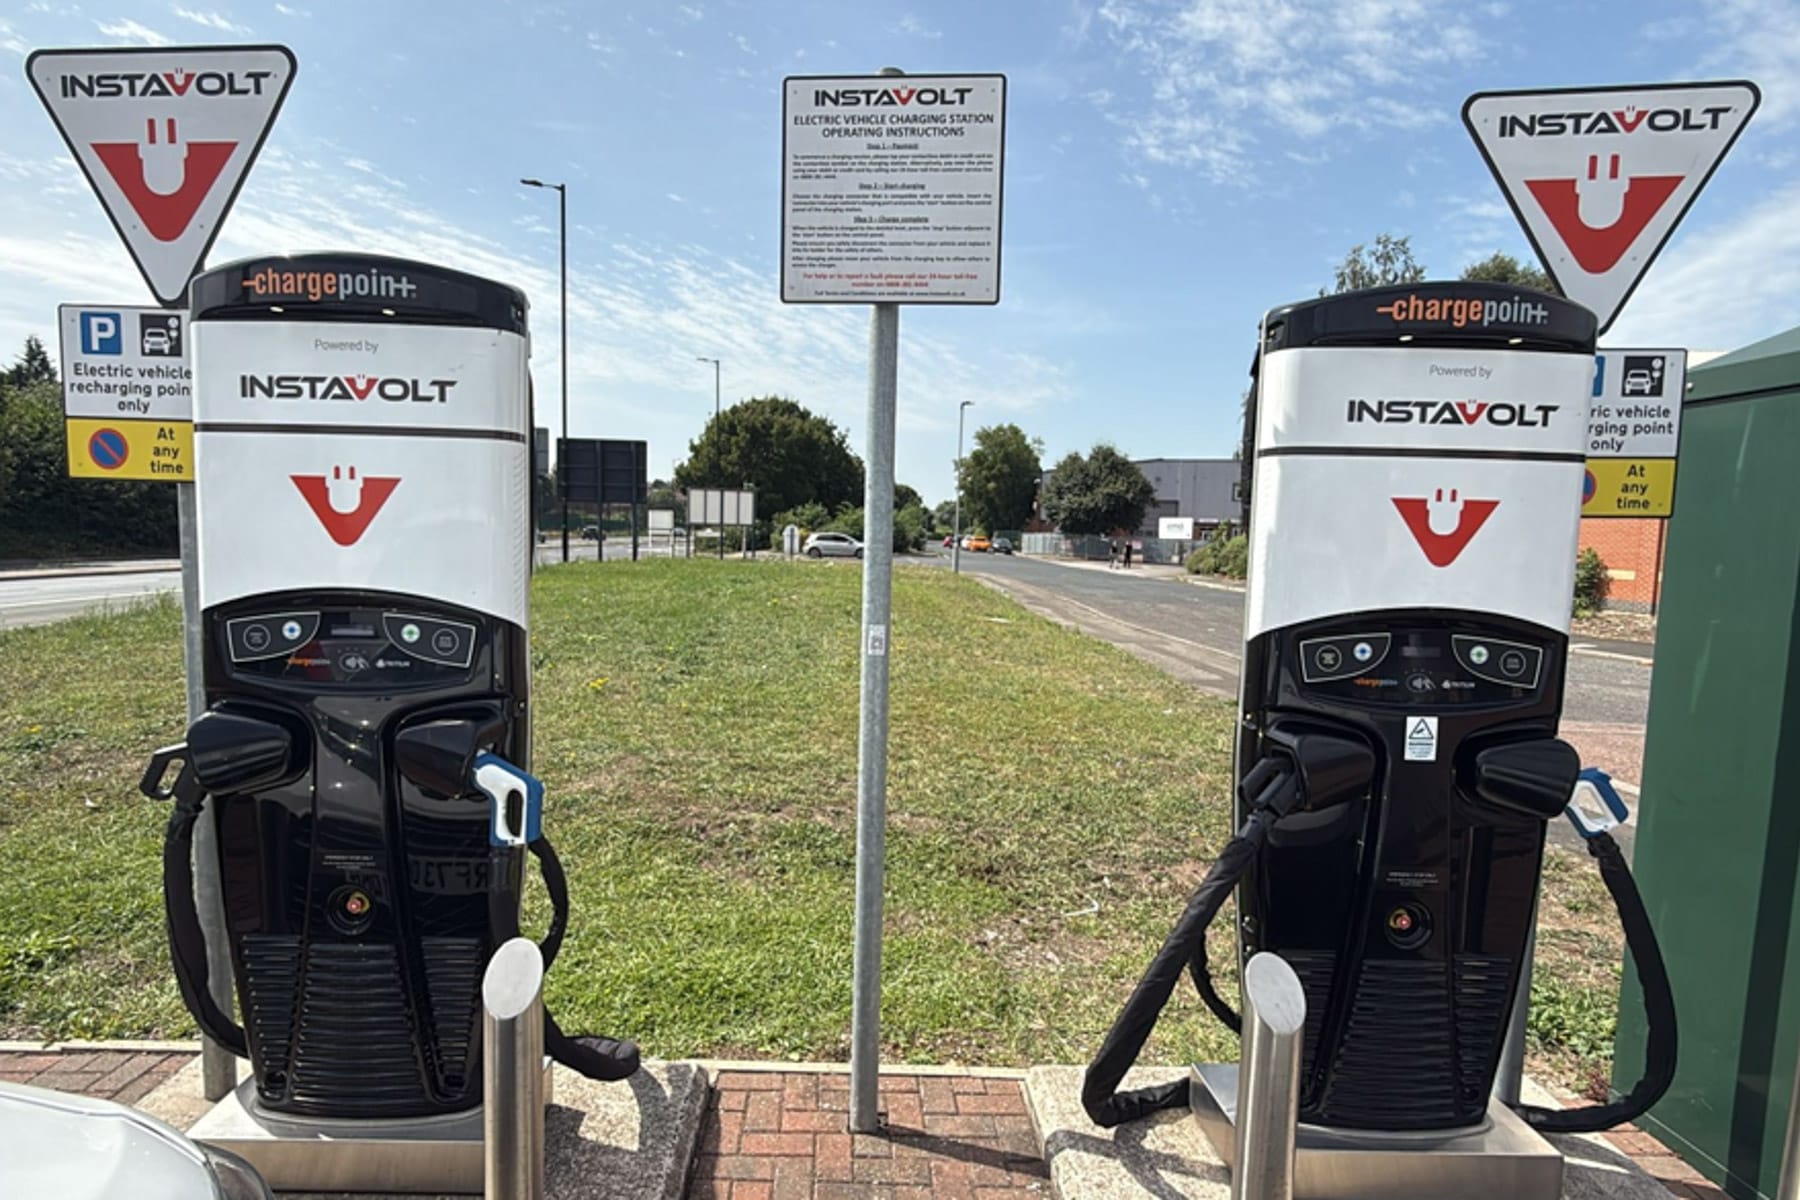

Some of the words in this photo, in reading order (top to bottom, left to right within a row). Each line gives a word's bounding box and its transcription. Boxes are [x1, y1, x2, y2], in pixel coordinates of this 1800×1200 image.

[62, 68, 271, 99] INSTAVOLT
[814, 86, 972, 107] INSTAVOLT
[793, 115, 841, 126] ELECTRIC
[843, 115, 886, 125] VEHICLE
[888, 114, 946, 125] CHARGING
[949, 113, 994, 124] STATION
[1498, 106, 1732, 138] INSTAVOLT
[822, 127, 883, 138] OPERATING
[886, 126, 965, 137] INSTRUCTIONS
[89, 317, 116, 351] P
[314, 339, 360, 353] Powered
[361, 339, 378, 355] by
[73, 363, 133, 378] Electric
[138, 365, 192, 379] vehicle
[1429, 364, 1476, 378] Powered
[1477, 365, 1492, 380] by
[70, 381, 152, 396] recharging
[157, 383, 192, 397] poin
[240, 374, 457, 403] INSTAVOLT
[117, 399, 151, 414] only
[1347, 399, 1559, 427] INSTAVOLT
[1616, 405, 1671, 419] vehicle
[157, 427, 175, 441] At
[1633, 422, 1674, 436] point
[153, 446, 180, 459] any
[1590, 438, 1625, 453] only
[150, 461, 184, 474] time
[1627, 465, 1646, 478] At
[1620, 482, 1649, 494] any
[1616, 497, 1651, 509] time
